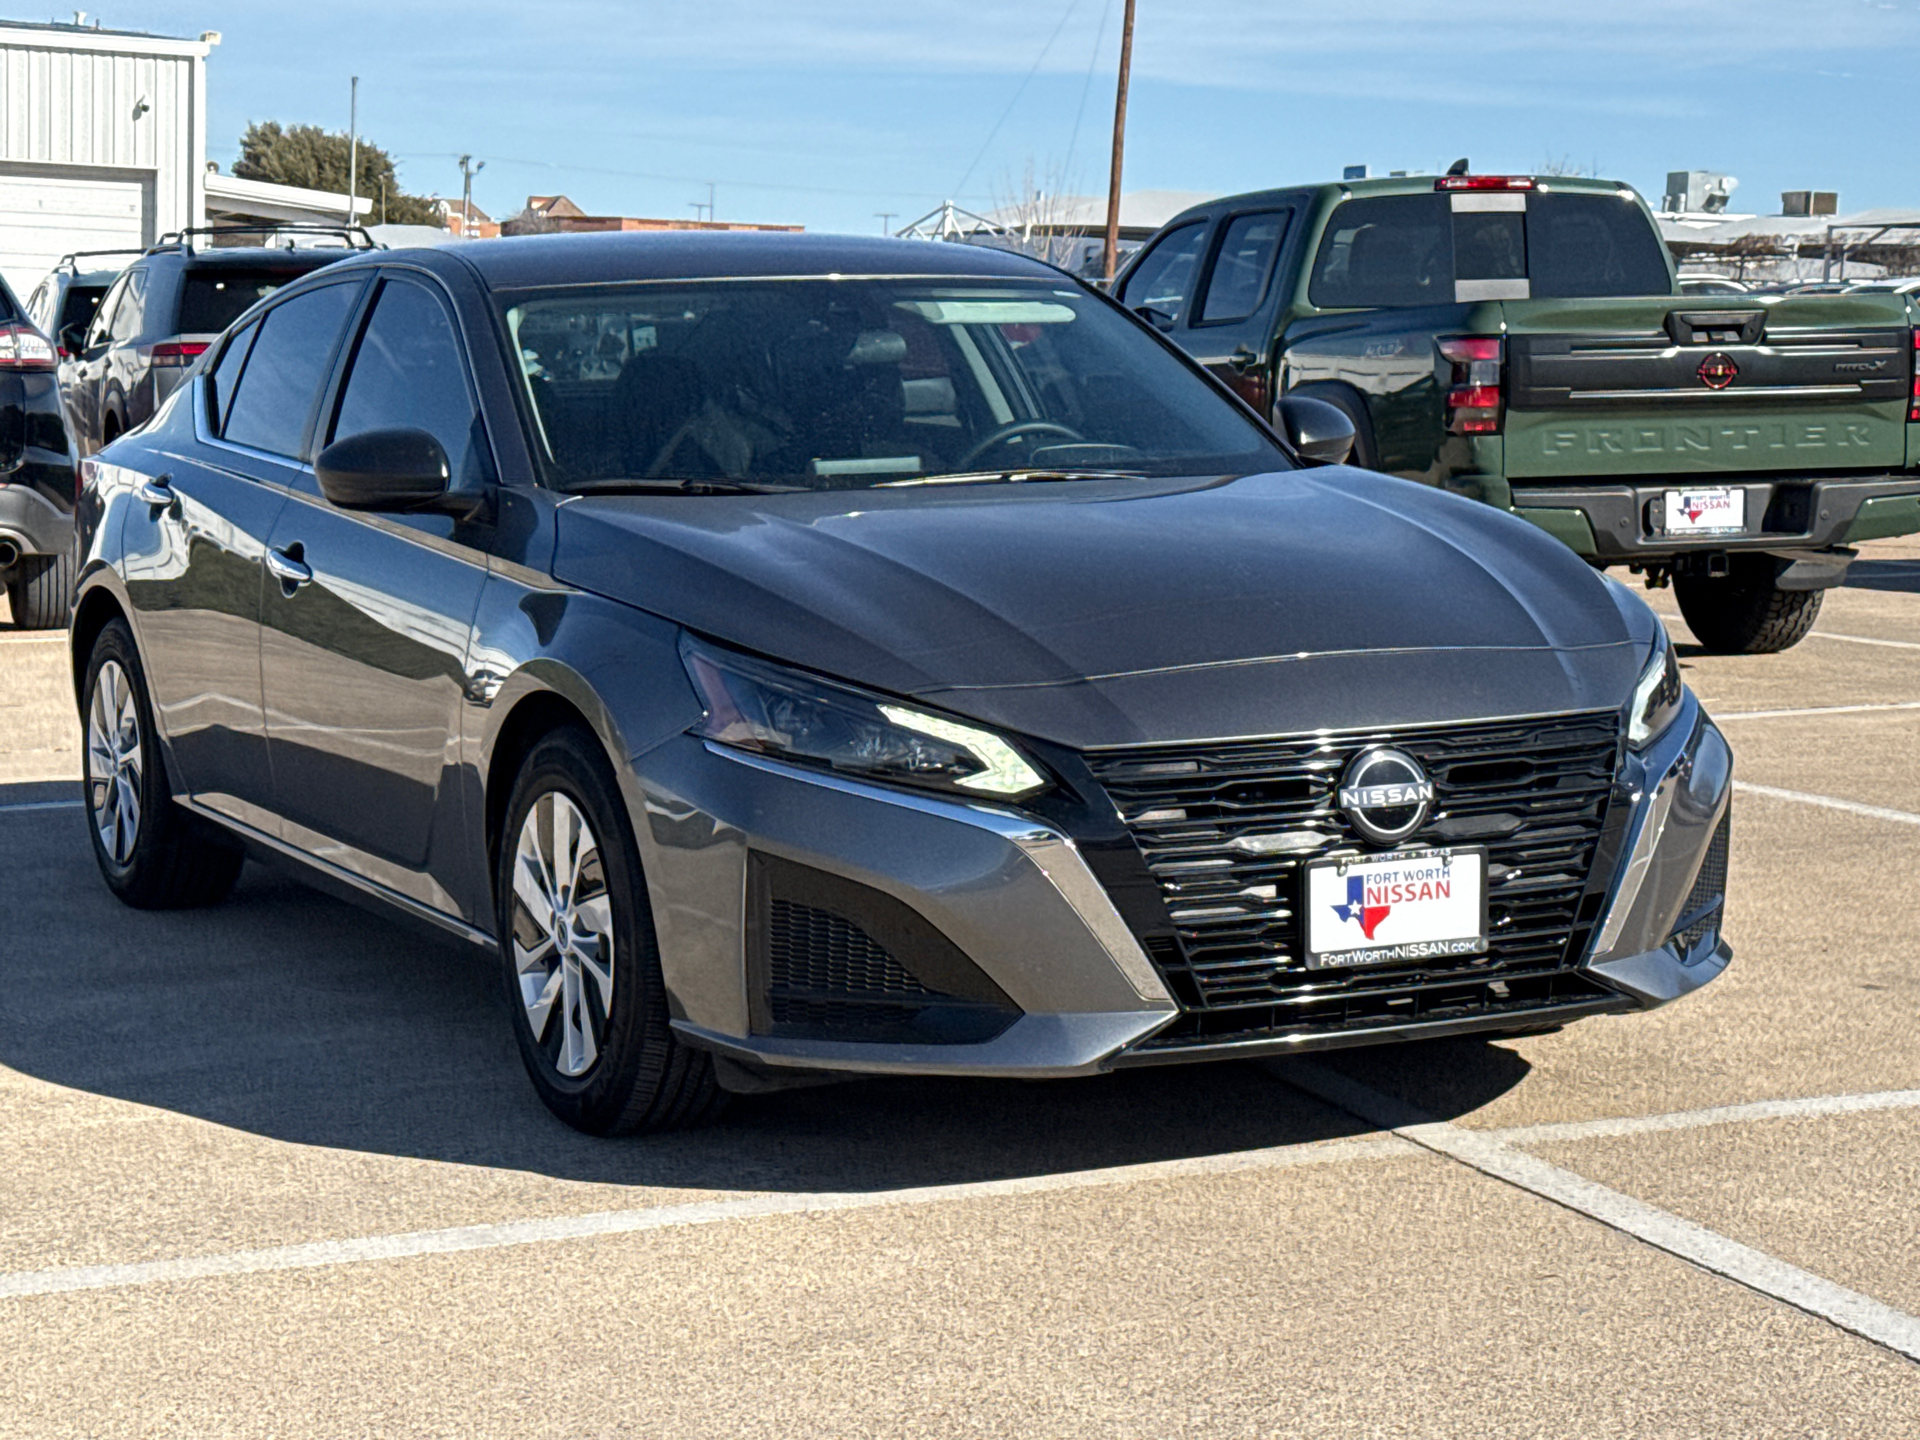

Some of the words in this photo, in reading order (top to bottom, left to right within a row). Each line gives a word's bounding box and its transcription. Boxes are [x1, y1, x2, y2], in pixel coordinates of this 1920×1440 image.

[1543, 422, 1870, 454] FRONTIER
[1692, 500, 1731, 510] NISSAN
[1342, 784, 1433, 806] NISSAN
[1341, 856, 1366, 865] FORT
[1371, 853, 1406, 862] WORTH
[1421, 848, 1452, 857] TEXAS
[1366, 871, 1400, 885] FORT
[1403, 867, 1451, 882] WORTH
[1366, 879, 1451, 906] NISSAN
